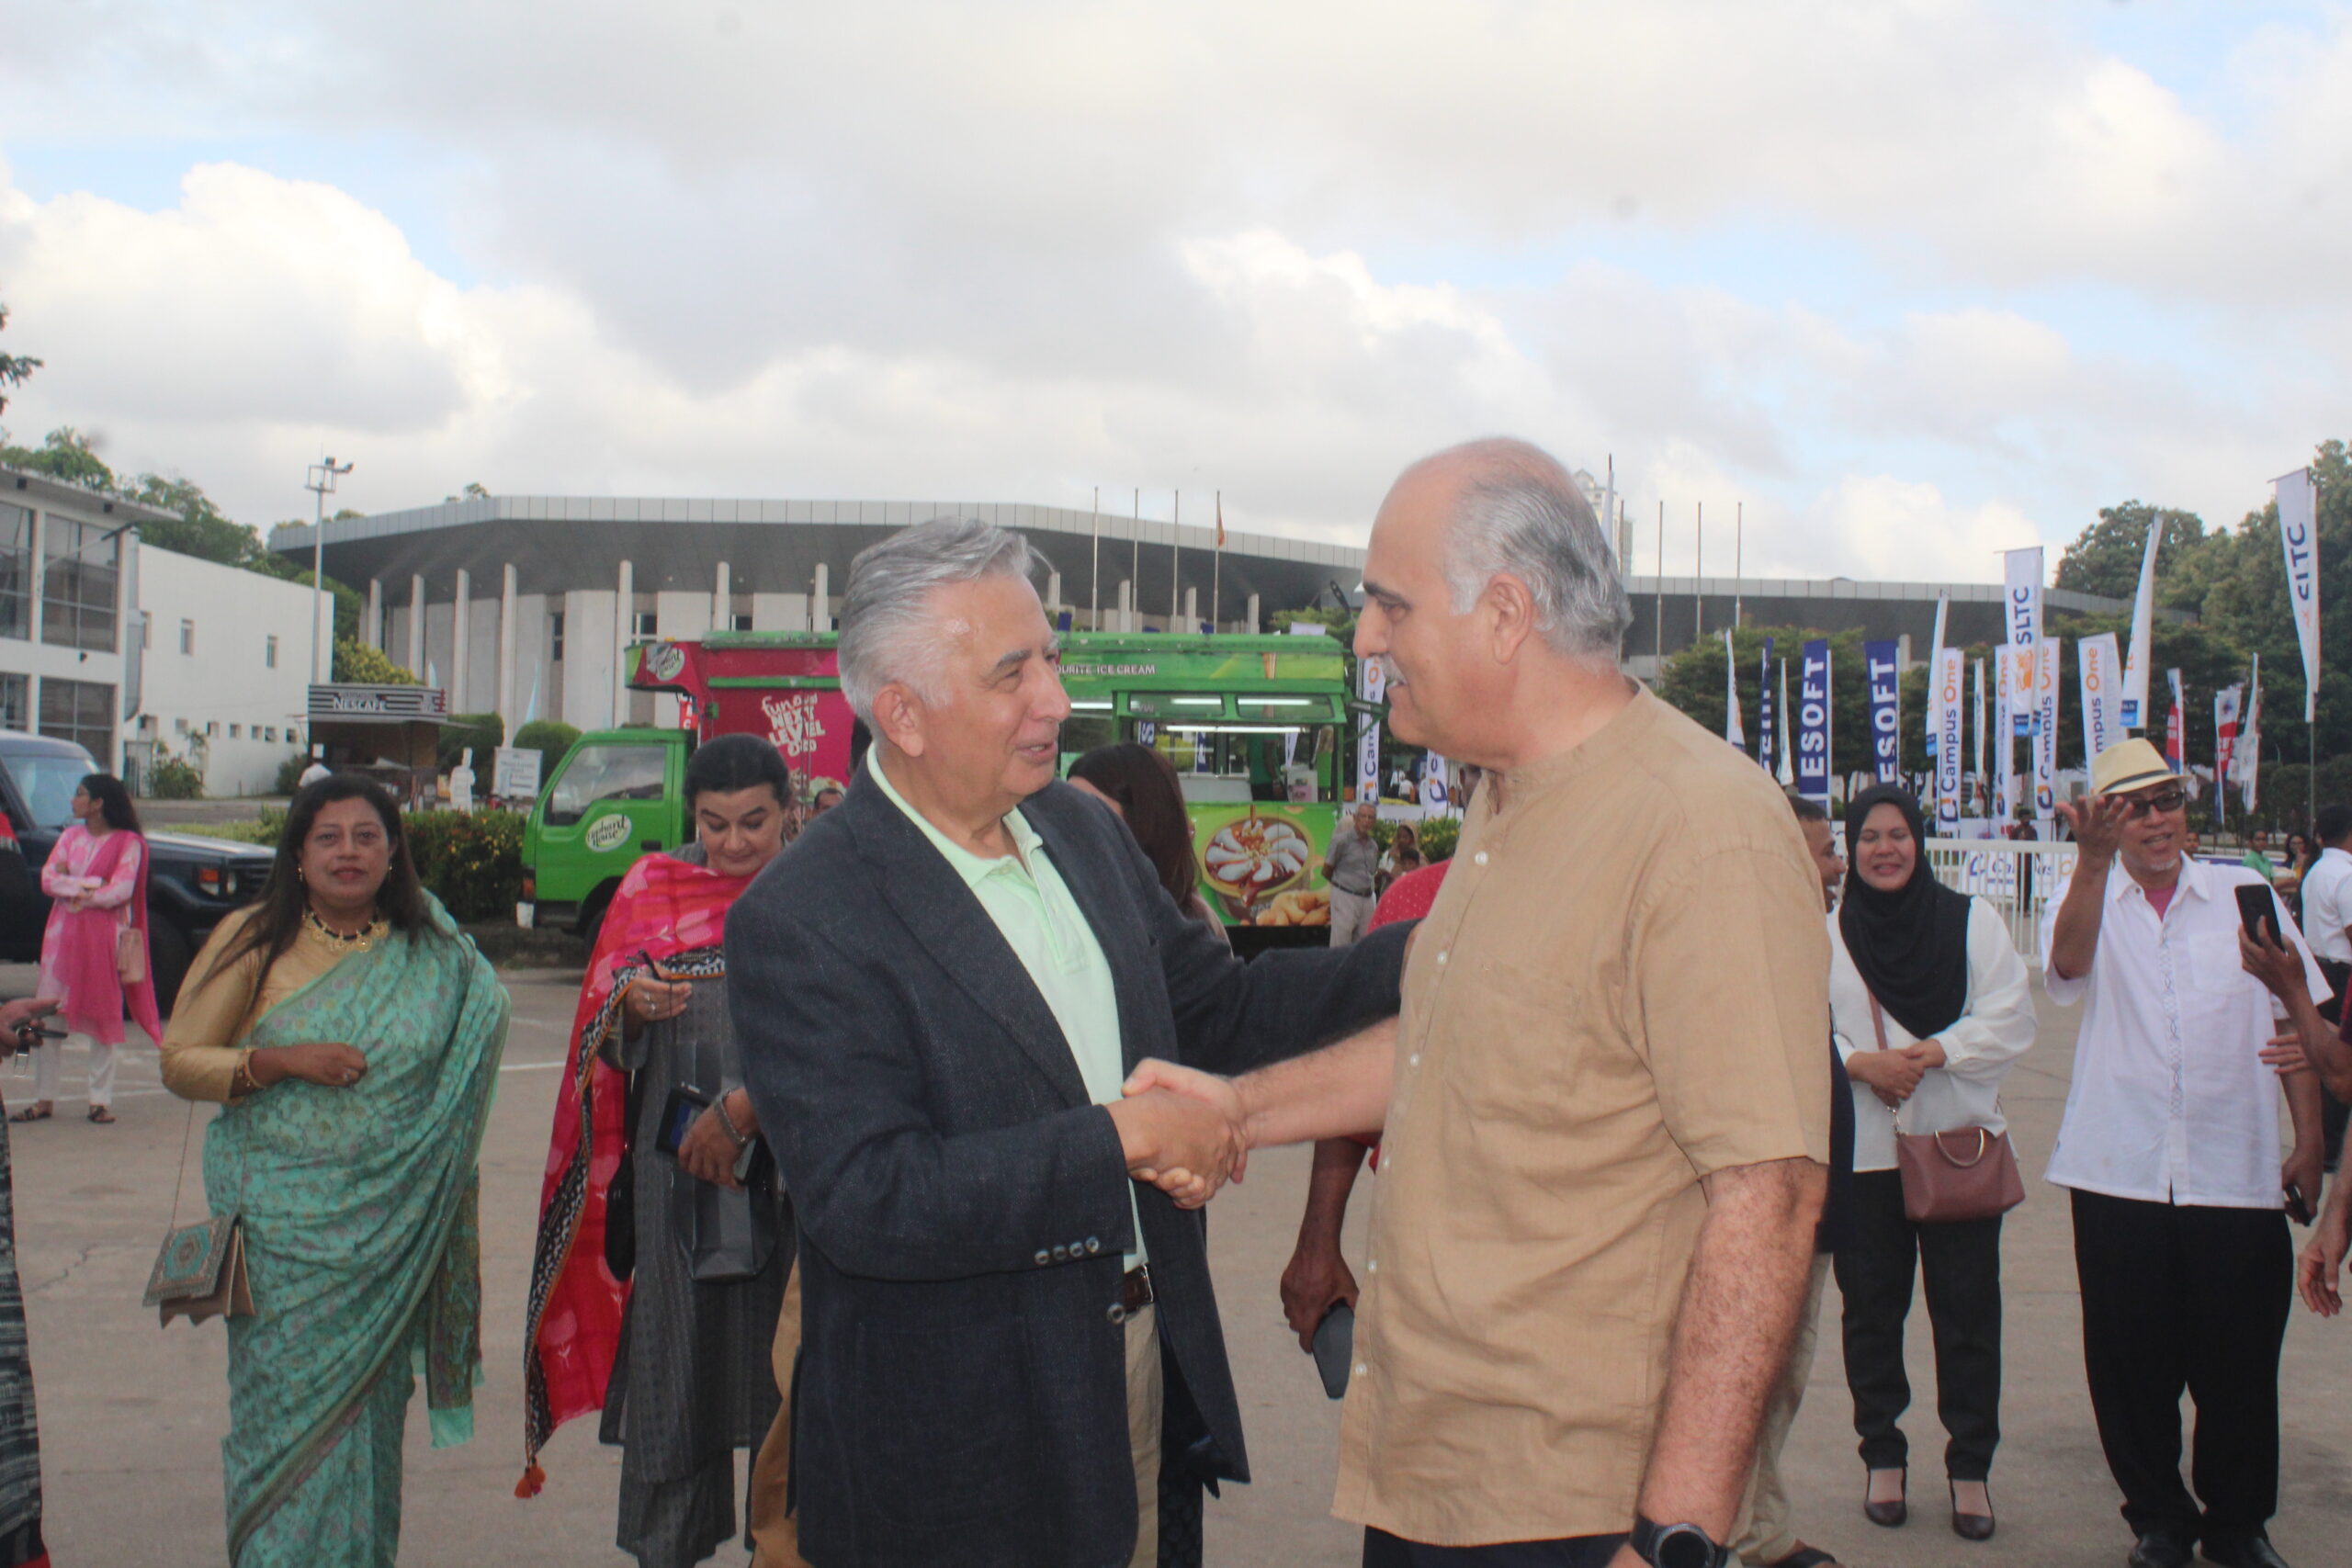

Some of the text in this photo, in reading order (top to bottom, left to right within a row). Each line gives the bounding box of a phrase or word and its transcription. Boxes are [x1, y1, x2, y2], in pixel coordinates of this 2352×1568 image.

[1057, 664, 1156, 675] OURITE ICE CREAM
[2013, 586, 2032, 646] SLTC
[768, 719, 826, 747] LEVEL
[1801, 657, 1825, 777] ESOFT
[1870, 658, 1897, 783] ESOFT
[1940, 659, 1959, 793] Campus One
[2086, 647, 2105, 754] mpus One
